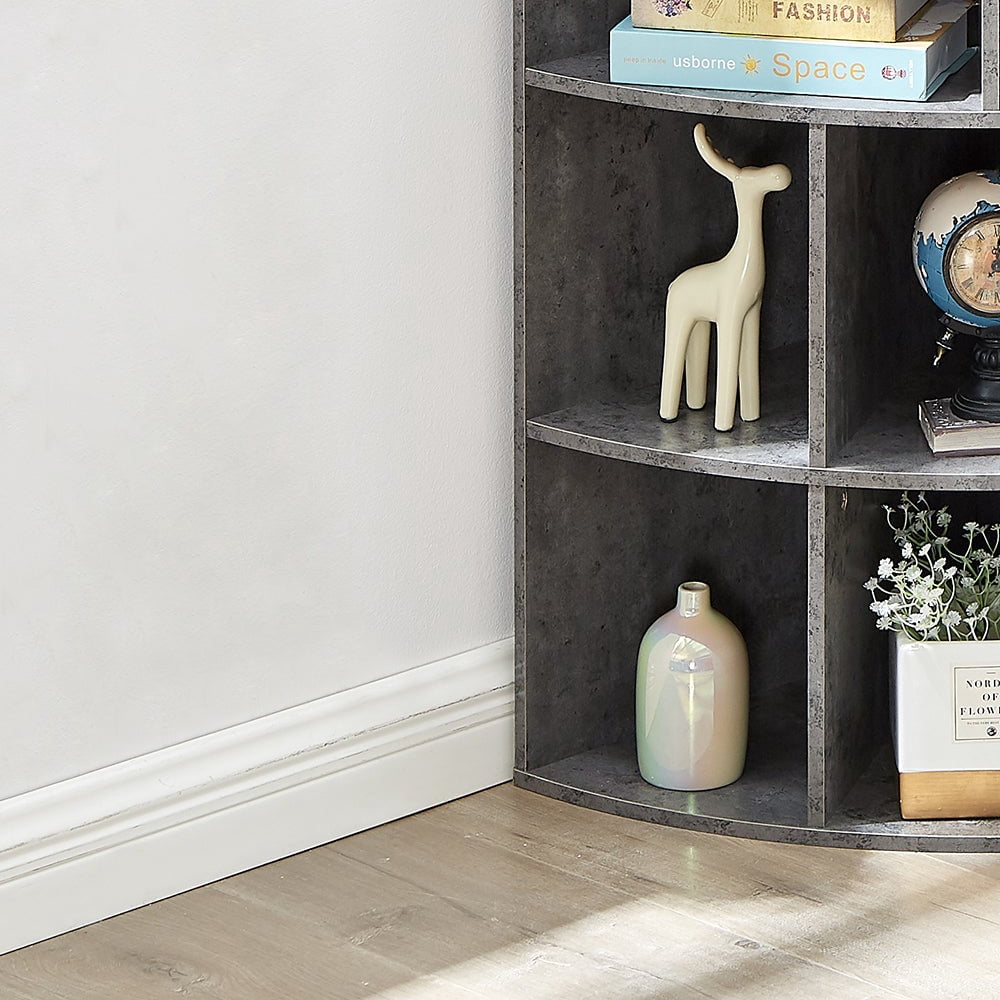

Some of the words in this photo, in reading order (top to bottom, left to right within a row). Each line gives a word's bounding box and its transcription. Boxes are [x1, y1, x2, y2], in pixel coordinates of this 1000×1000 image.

[772, 1, 871, 24] FASHION
[673, 55, 736, 70] usborne
[773, 53, 865, 84] Space
[982, 693, 999, 701] OF
